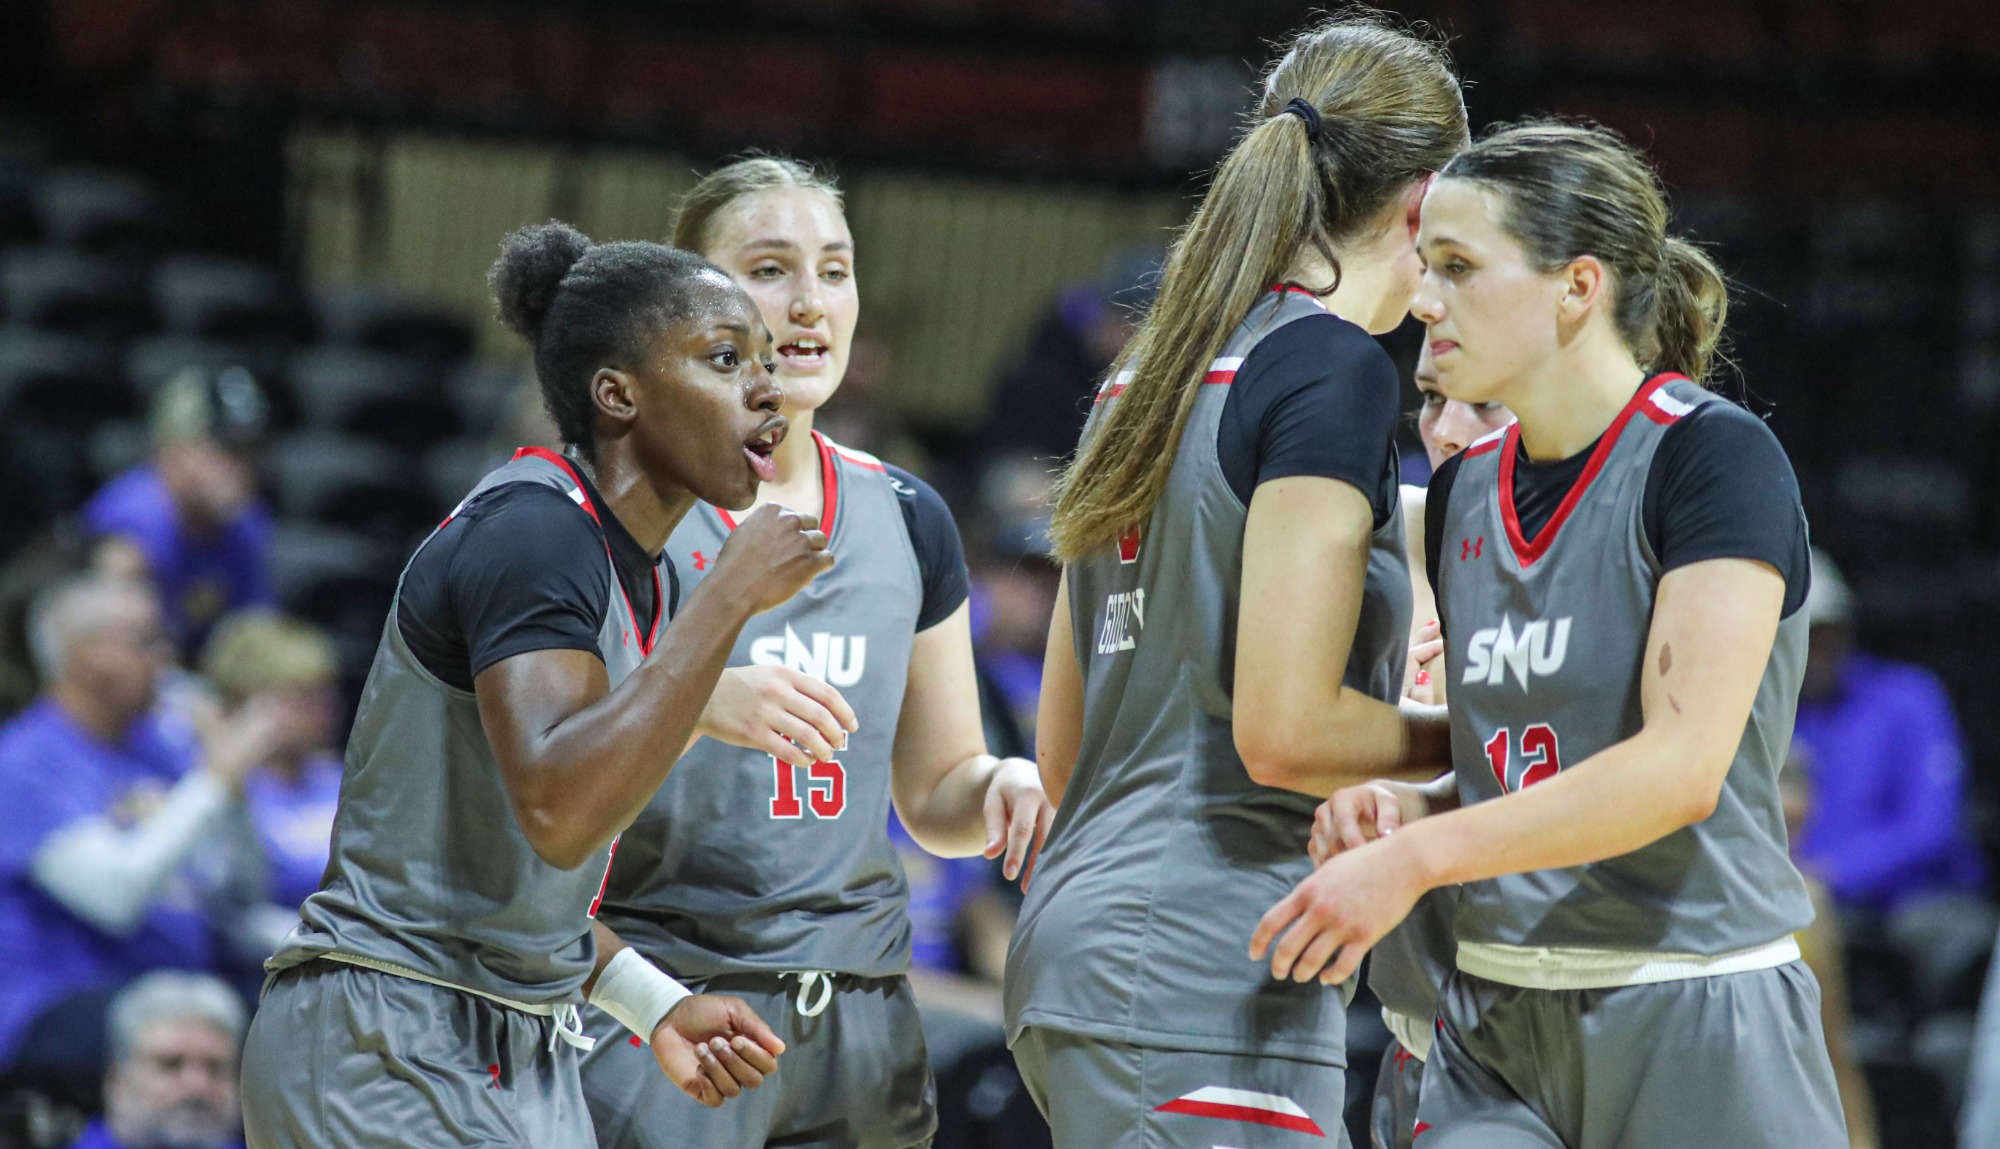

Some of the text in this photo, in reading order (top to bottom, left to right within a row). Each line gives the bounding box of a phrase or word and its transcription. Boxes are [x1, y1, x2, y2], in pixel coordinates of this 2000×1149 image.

[750, 621, 866, 687] SNU
[1462, 611, 1573, 695] SNU
[768, 730, 848, 819] 15
[1485, 722, 1561, 796] 12
